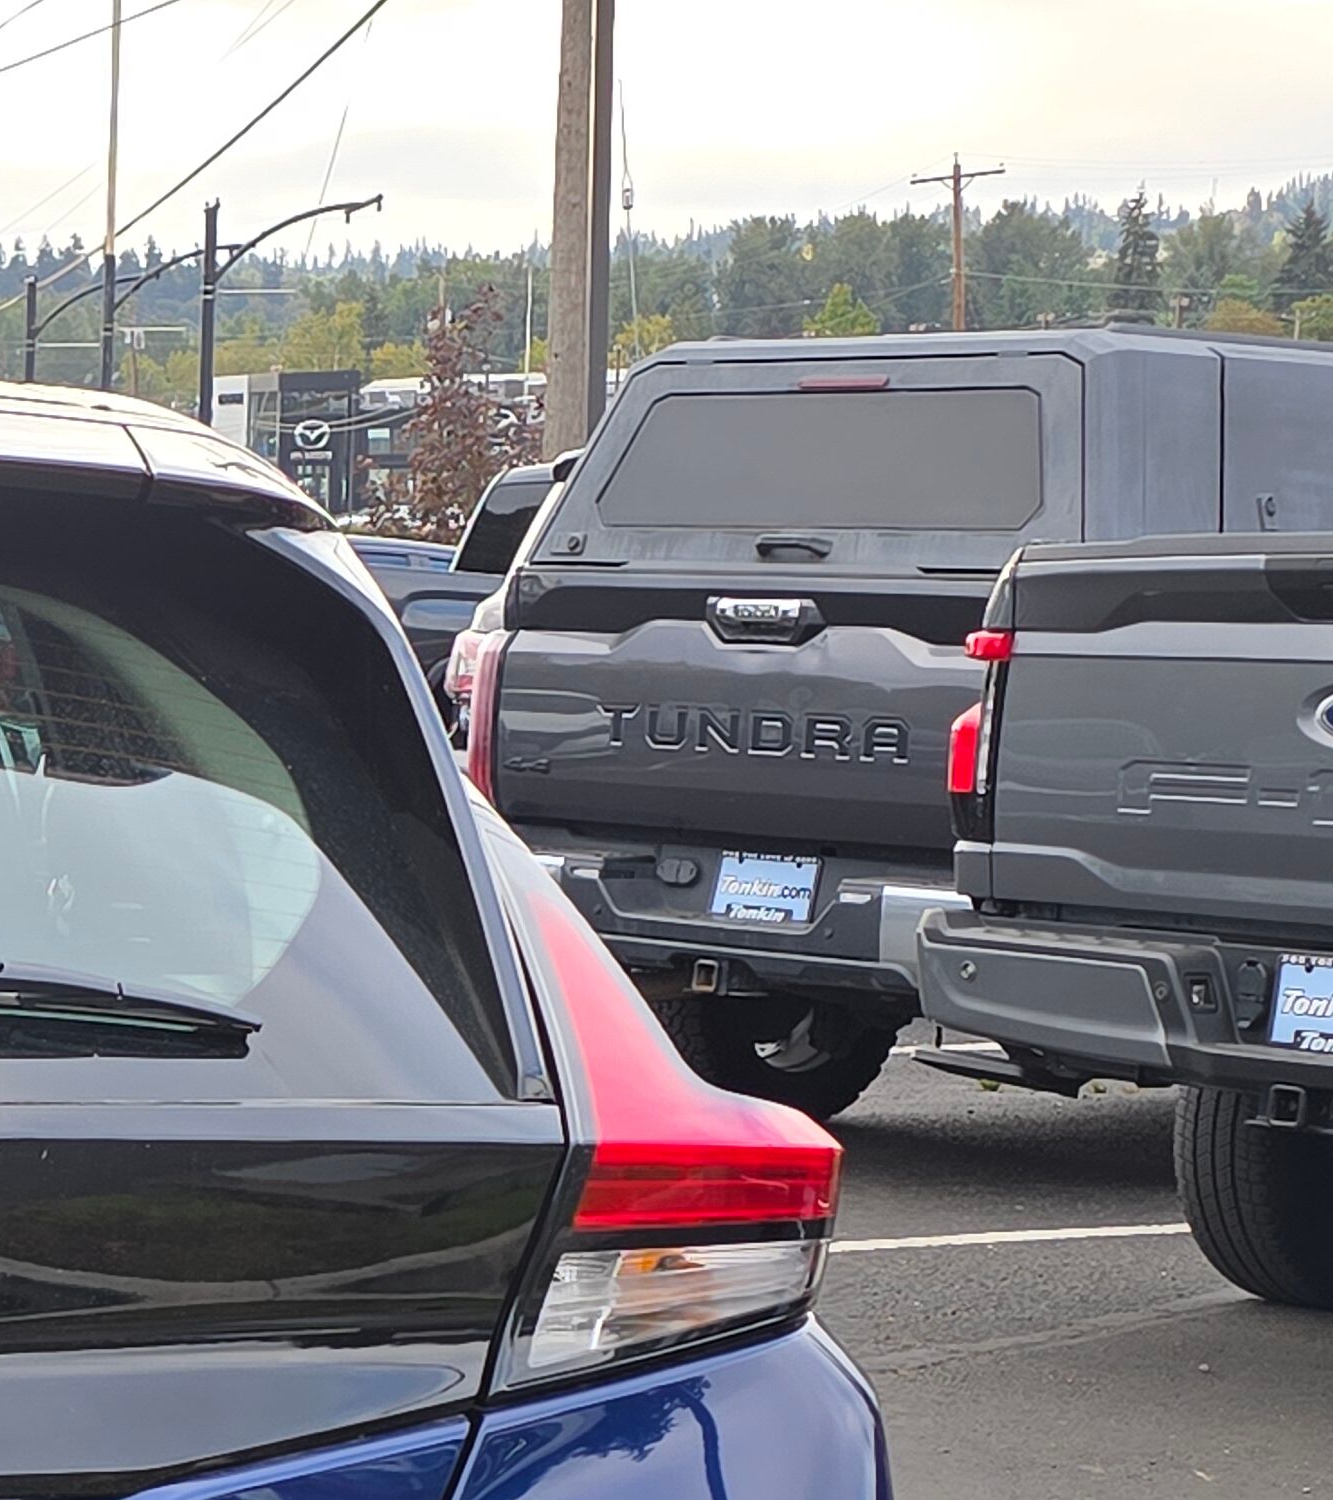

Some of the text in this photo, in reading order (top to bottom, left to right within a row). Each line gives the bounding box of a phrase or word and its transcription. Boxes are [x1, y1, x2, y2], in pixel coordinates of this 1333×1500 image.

[596, 703, 911, 764] TUNDRA
[720, 875, 812, 899] Tonkin.com
[728, 903, 785, 922] Tonkin
